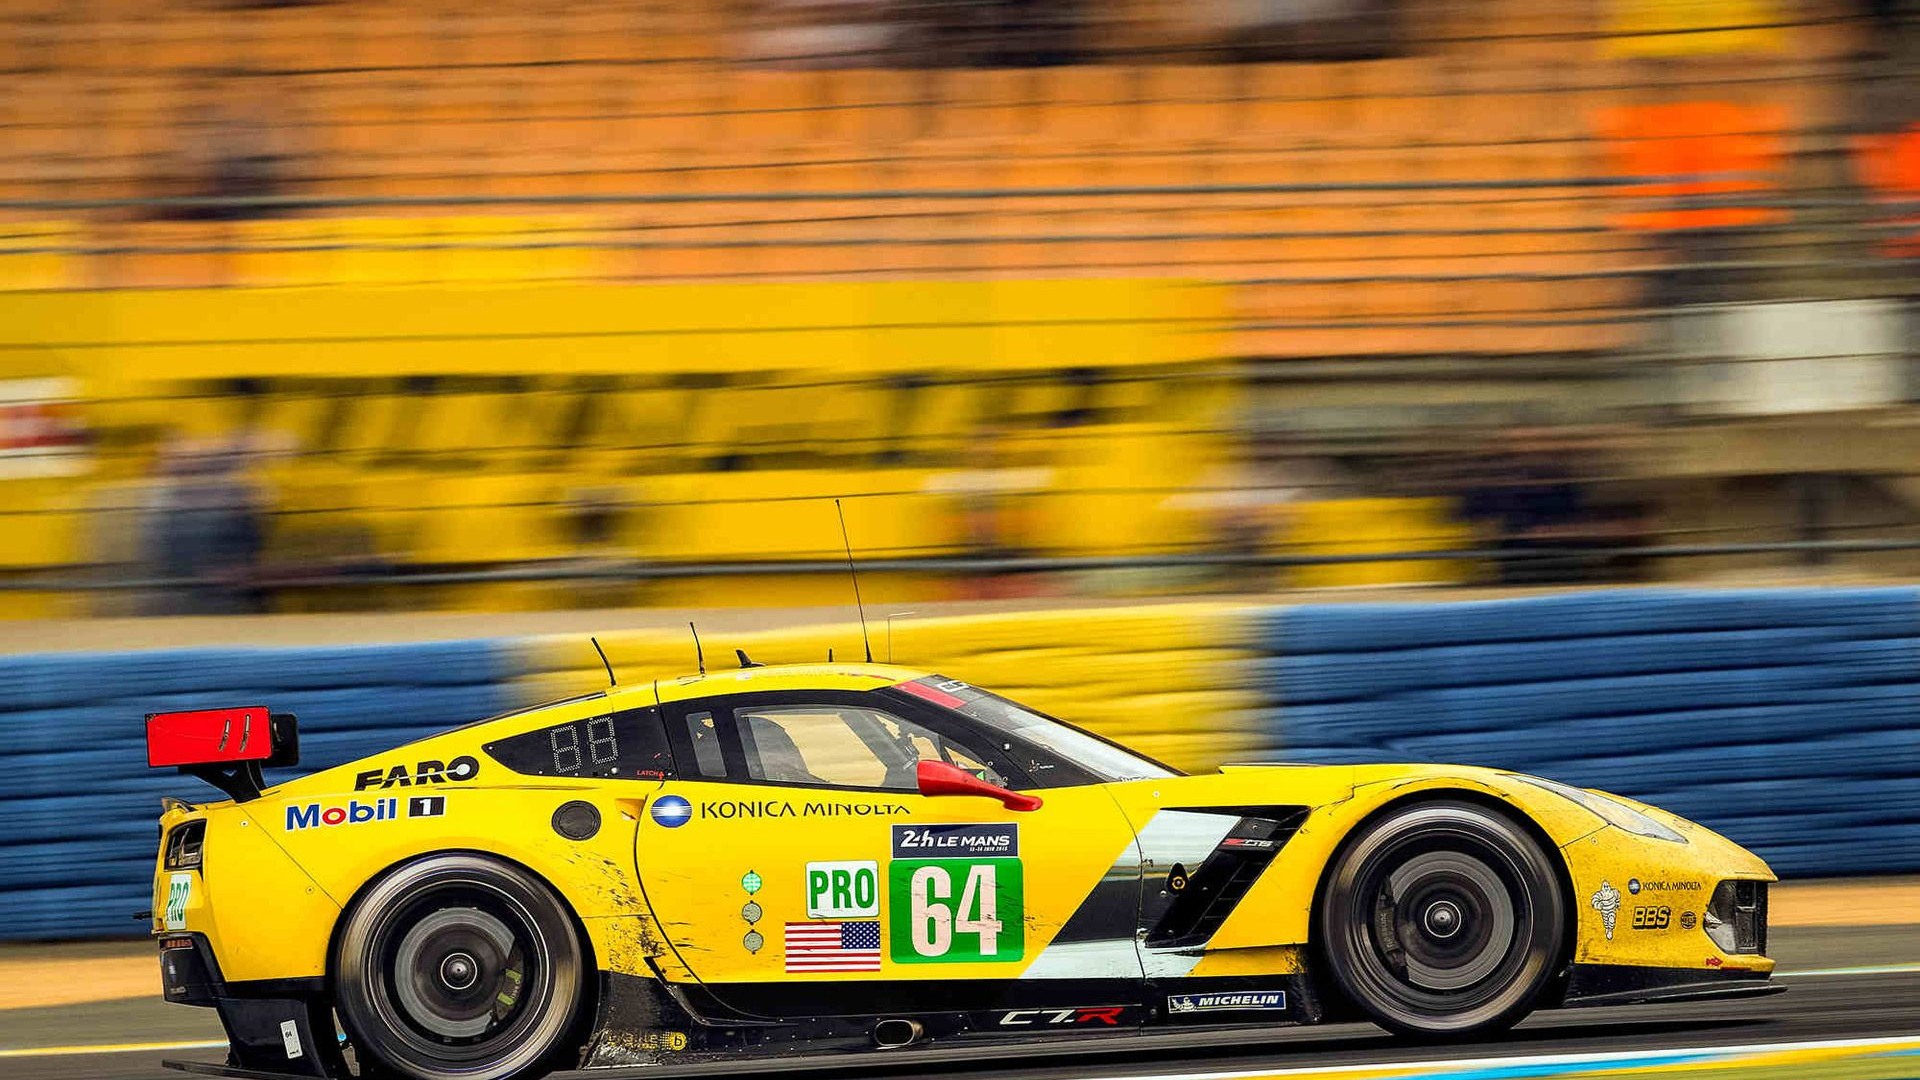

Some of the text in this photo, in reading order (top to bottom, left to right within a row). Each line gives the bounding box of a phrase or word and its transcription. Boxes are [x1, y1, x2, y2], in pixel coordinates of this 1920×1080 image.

[354, 755, 480, 791] FARO
[285, 798, 398, 831] Mobil
[701, 801, 911, 819] KONICA MINOLTA
[937, 836, 959, 847] LE
[960, 835, 1010, 846] MANS
[809, 868, 876, 910] PRO
[1642, 881, 1702, 891] KONICA MINOLTA
[167, 882, 189, 922] PRO
[911, 864, 1003, 957] 64
[1632, 906, 1671, 929] BBS
[1198, 995, 1280, 1006] MICHELIN
